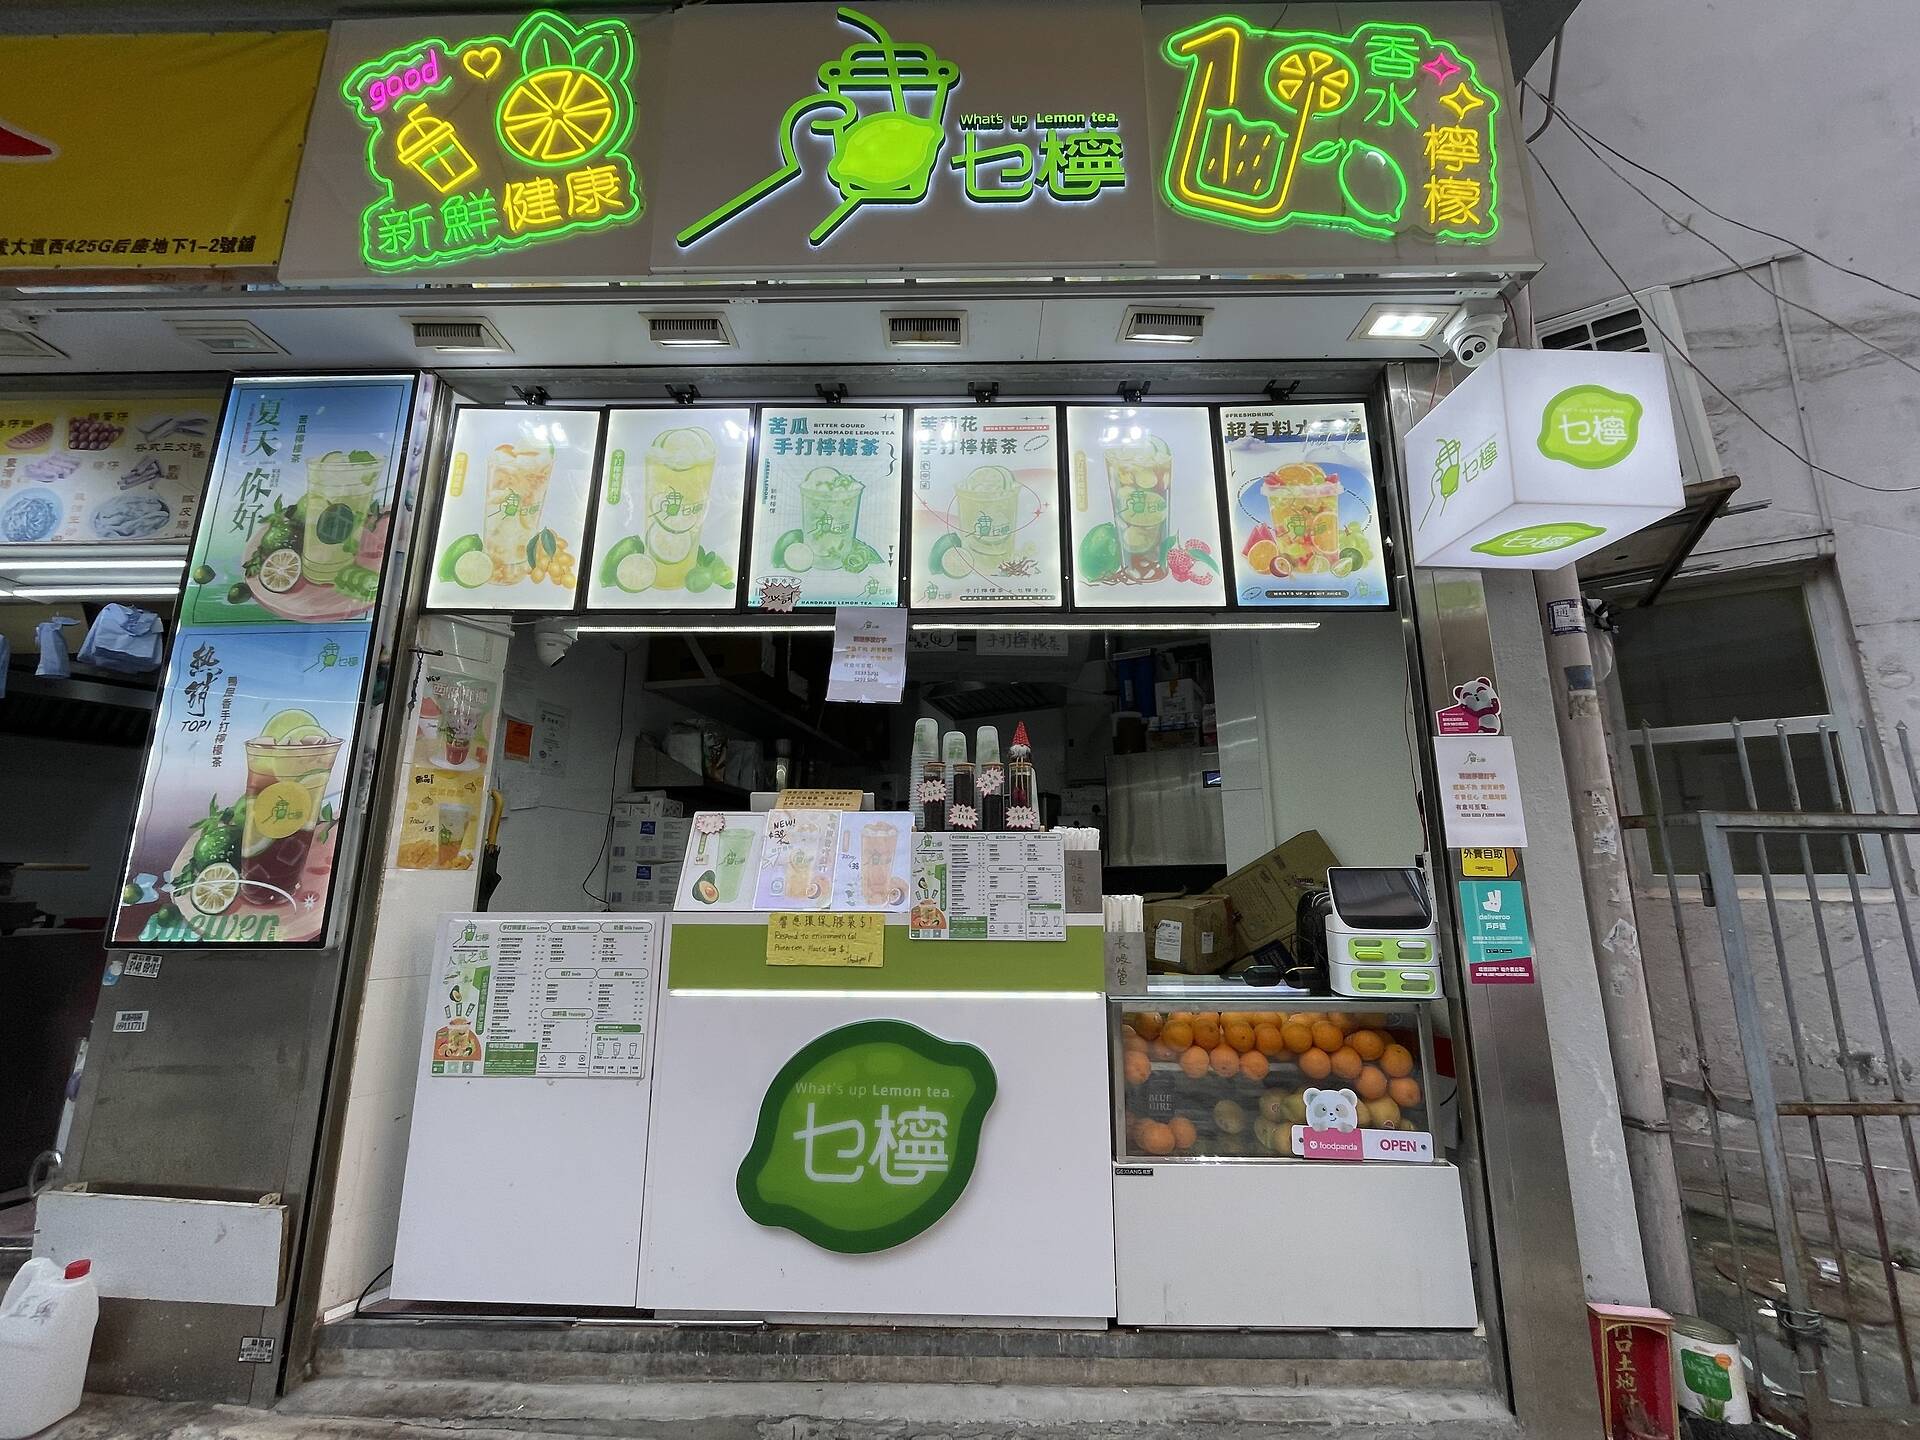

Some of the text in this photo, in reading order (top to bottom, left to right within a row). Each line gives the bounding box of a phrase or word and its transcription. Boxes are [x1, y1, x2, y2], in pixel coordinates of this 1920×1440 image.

[369, 49, 438, 111] good
[960, 111, 1119, 129] What's up Lemon tea.
[1363, 35, 1481, 225] 香水 檸檬
[951, 128, 1126, 201] 乜檸
[378, 165, 625, 253] 新鮮健康
[769, 416, 809, 435] 苦瓜
[773, 437, 880, 457] 手打檸檬茶
[920, 437, 1018, 455] 手打檸檬茶
[229, 467, 272, 542] 你好
[773, 818, 796, 830] NEW!
[1463, 847, 1504, 859] 外賣自取
[794, 1082, 955, 1098] What's up Lemon tea.
[793, 1102, 949, 1185] 乜檸
[1320, 1141, 1358, 1152] foodpanda
[1380, 1139, 1417, 1152] OPEN
